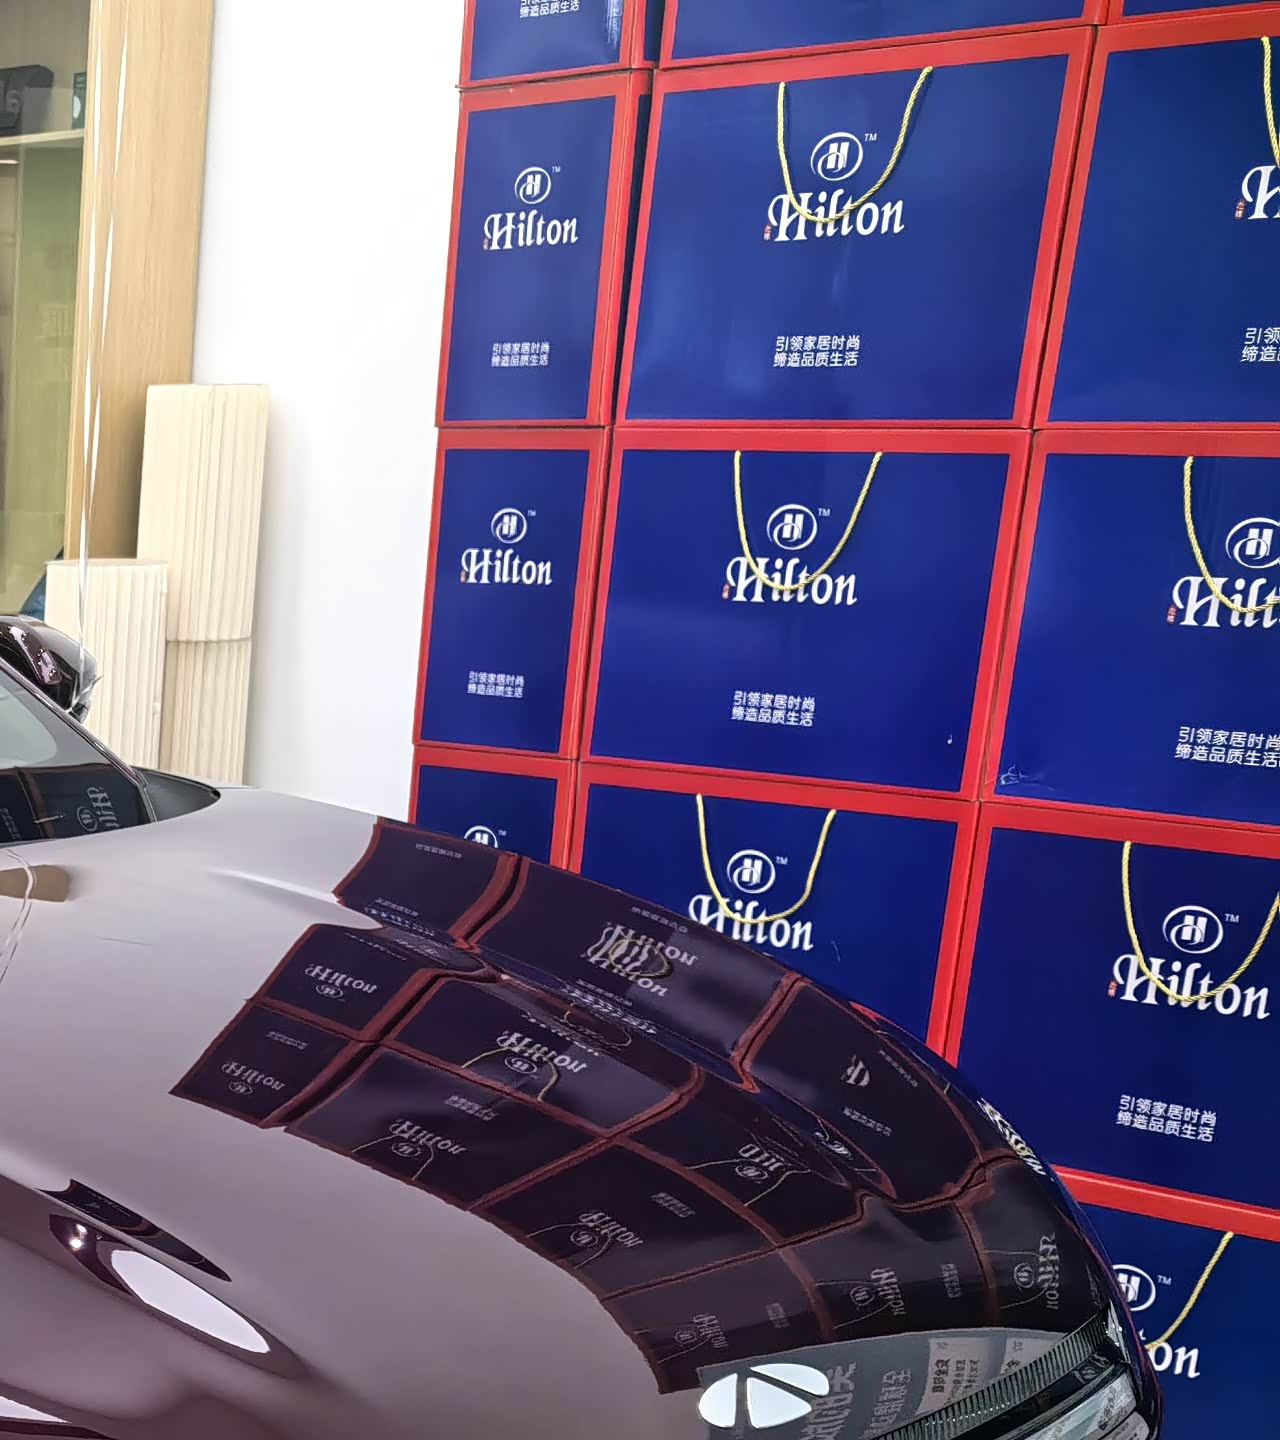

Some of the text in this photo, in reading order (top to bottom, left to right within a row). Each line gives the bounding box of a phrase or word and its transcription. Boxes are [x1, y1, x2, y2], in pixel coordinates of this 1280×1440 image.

[484, 209, 578, 250] Hilton
[768, 189, 904, 241] Hilton
[773, 351, 858, 367] 缔造品质生活
[776, 335, 860, 351] 引领家居时尚
[461, 548, 552, 585] Hilton
[726, 556, 857, 606] Hilton
[1172, 576, 1280, 628] Hilt
[731, 706, 814, 727] 缔造品质生活
[733, 690, 816, 712] 引领家居时尚
[689, 894, 814, 951] Hilton
[1113, 954, 1270, 1020] Hilton
[1116, 1110, 1215, 1142] 缔造品质生活
[1119, 1094, 1217, 1127] 引领家居时尚
